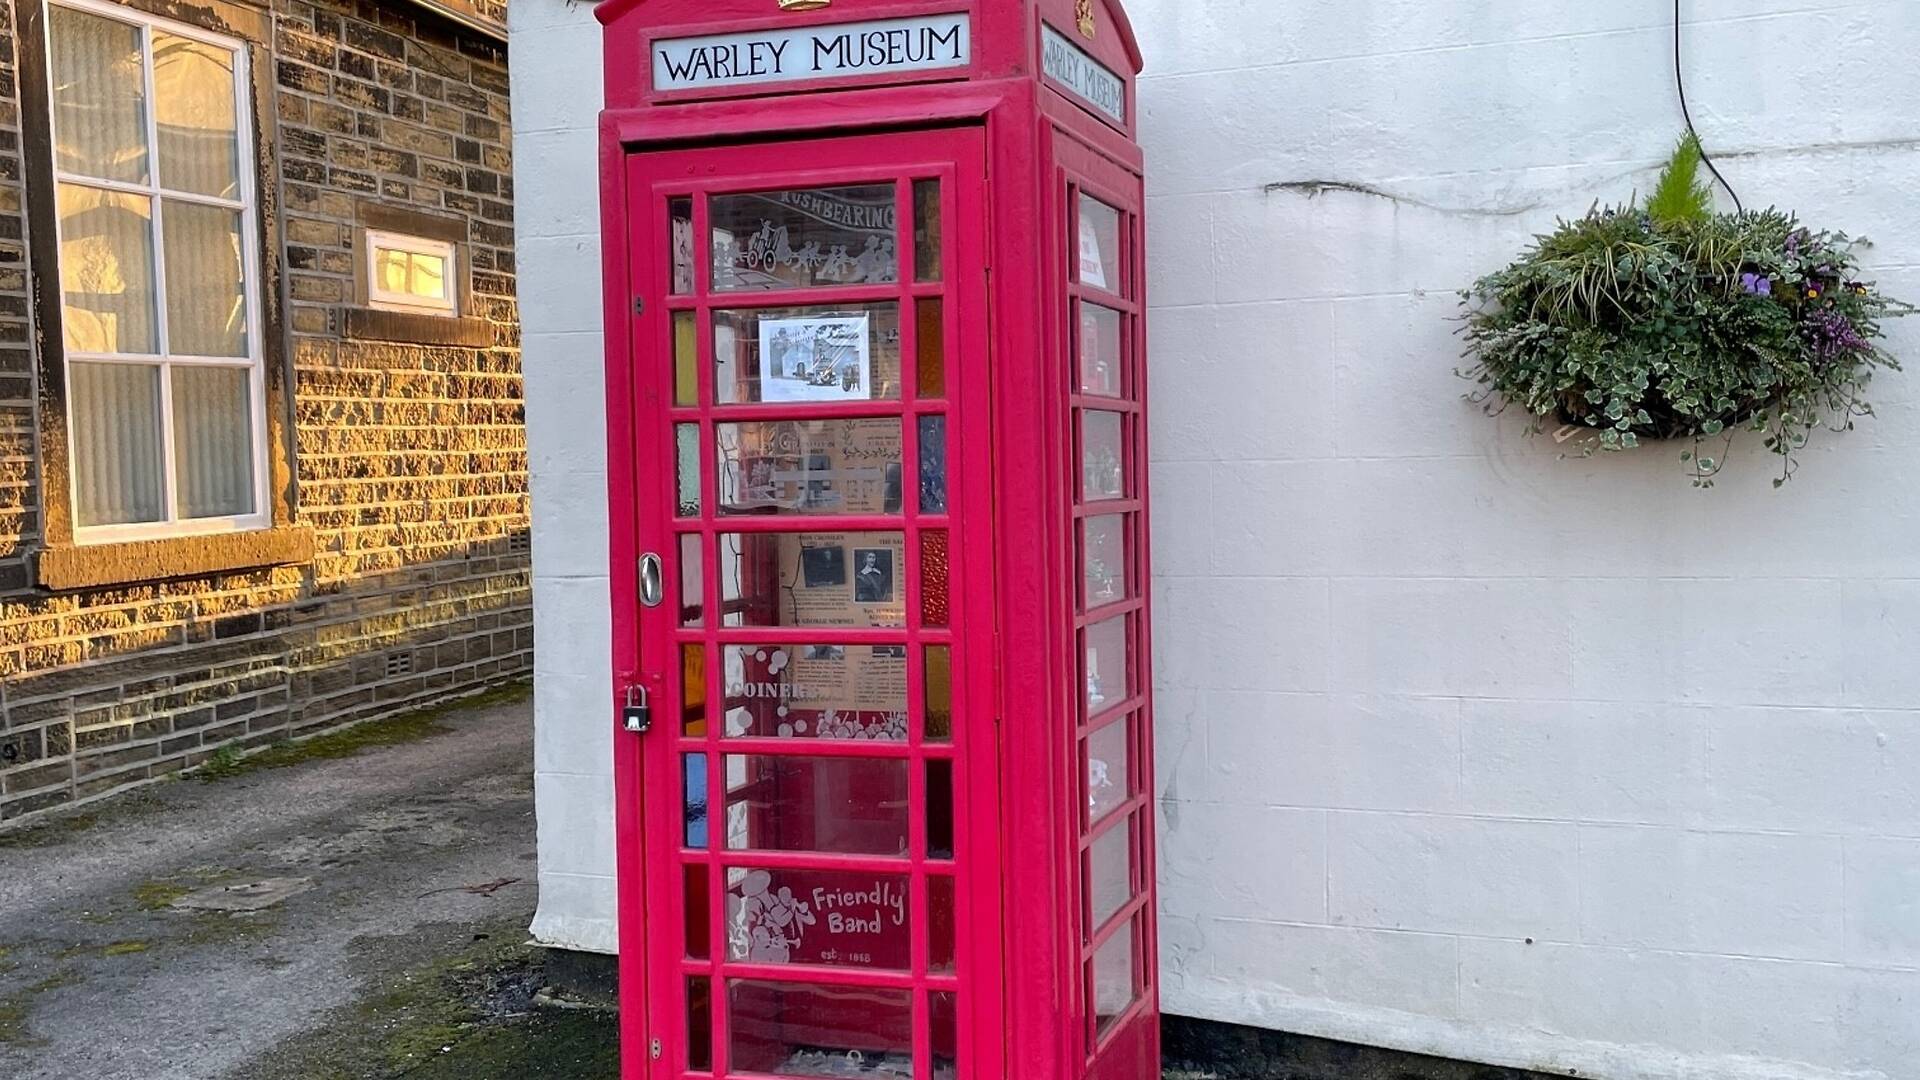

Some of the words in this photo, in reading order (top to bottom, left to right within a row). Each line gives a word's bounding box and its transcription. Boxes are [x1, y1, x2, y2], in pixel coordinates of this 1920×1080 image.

[660, 39, 790, 81] WARLEY
[811, 24, 961, 71] MUSEUM
[1043, 40, 1080, 88] WARLEY
[1084, 63, 1122, 118] MUSEUM
[812, 881, 904, 925] Friendly
[828, 909, 881, 933] Band
